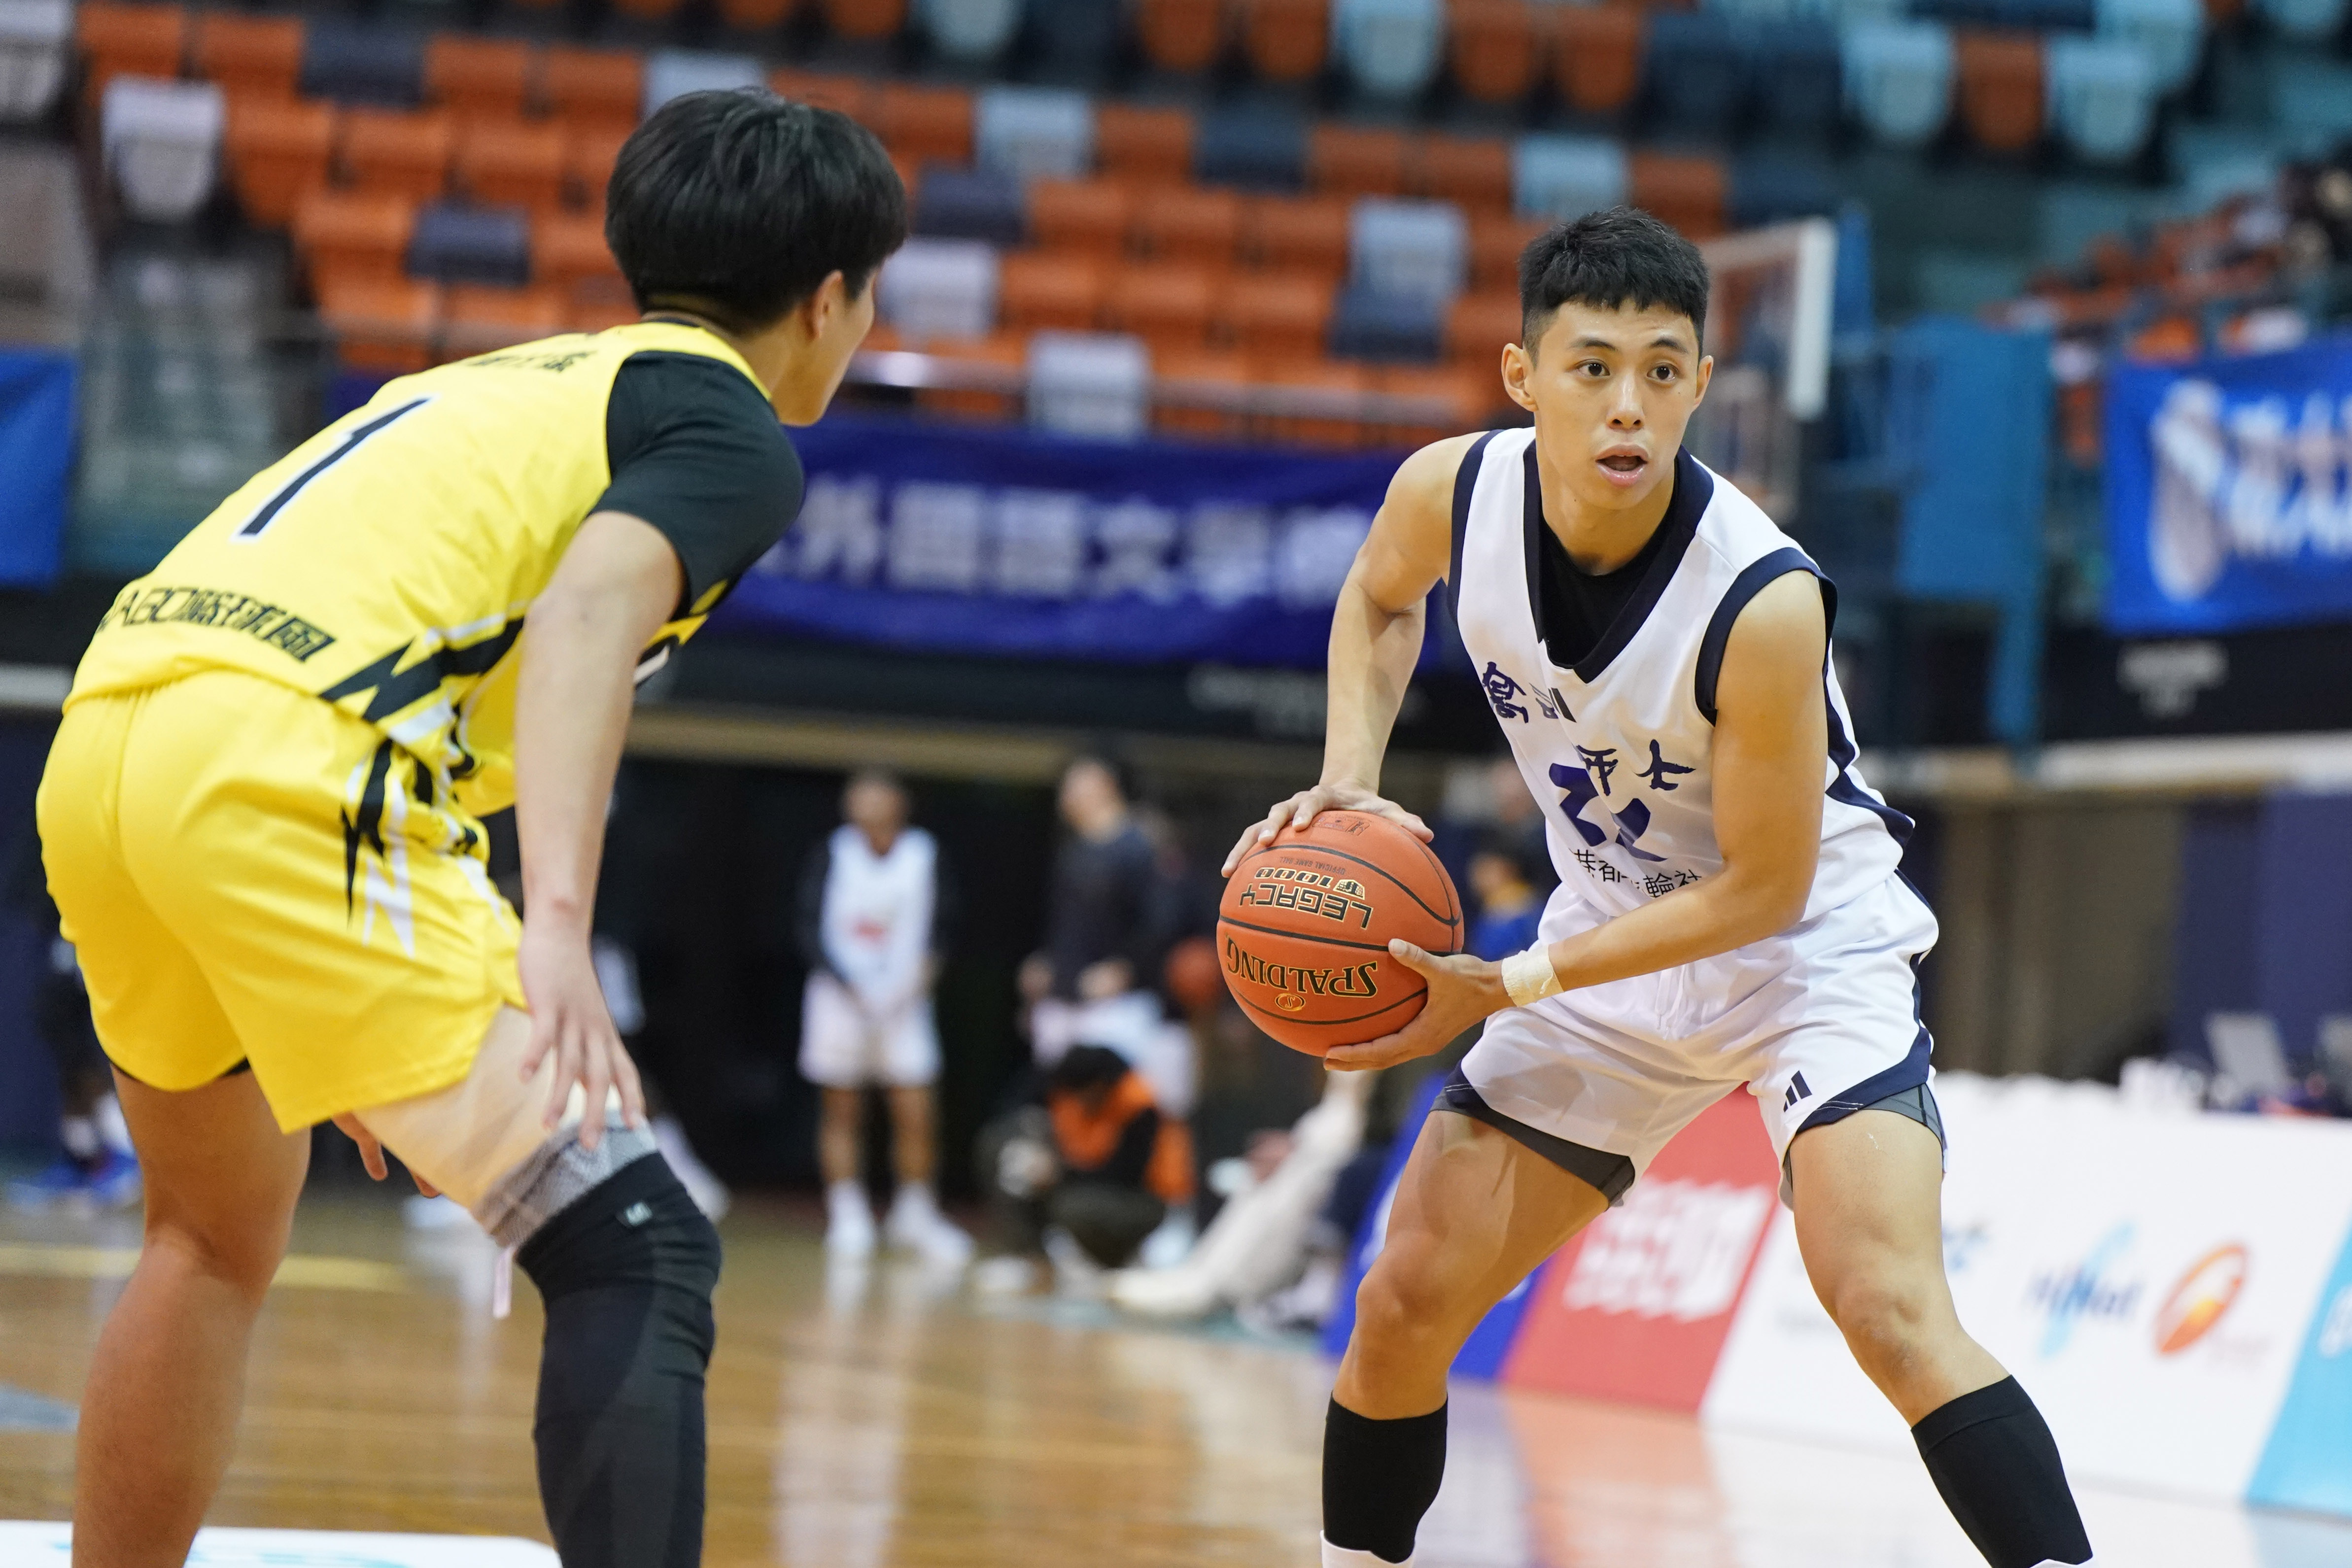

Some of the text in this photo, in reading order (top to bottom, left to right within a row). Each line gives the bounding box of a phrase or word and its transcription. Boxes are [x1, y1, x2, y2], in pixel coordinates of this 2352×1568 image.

[235, 394, 436, 539] 1
[1254, 867, 1334, 889] 1000
[1294, 859, 1313, 867] GAME
[1315, 861, 1346, 876] OFFICIAL
[1240, 883, 1374, 930] LEGACY
[1226, 935, 1378, 998] SPALDING
